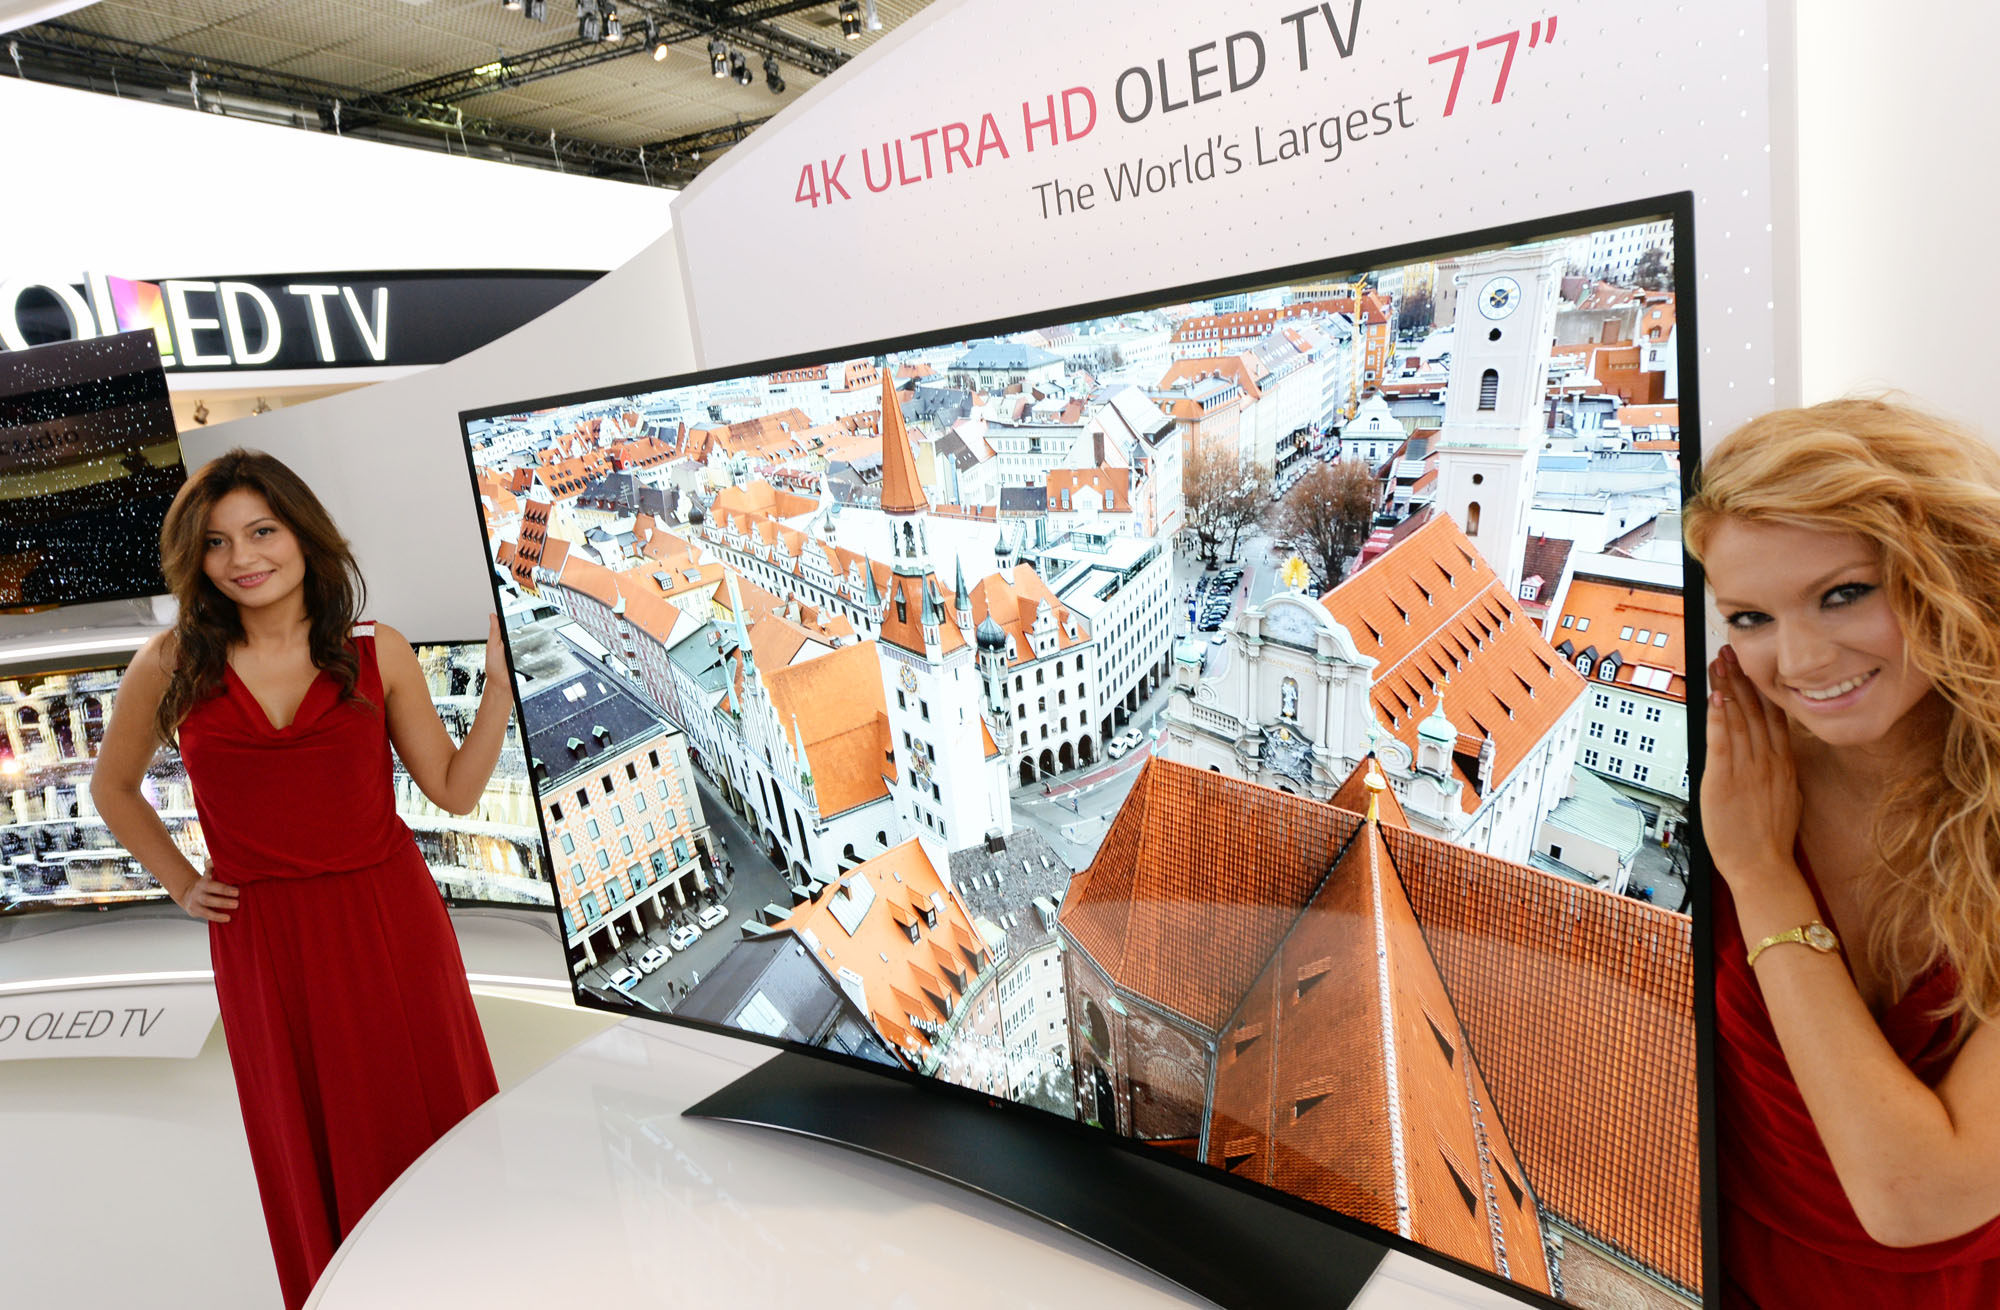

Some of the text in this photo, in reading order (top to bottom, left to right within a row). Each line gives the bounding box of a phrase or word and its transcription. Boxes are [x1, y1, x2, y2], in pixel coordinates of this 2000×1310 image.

[795, 0, 1362, 208] 4K ULTRA HD OLED TV
[1032, 179, 1095, 220] The
[1104, 135, 1242, 202] World’s
[1255, 91, 1414, 162] Largest
[0, 268, 389, 367] OLED TV
[25, 1010, 115, 1042] OLED
[120, 1008, 165, 1038] TV
